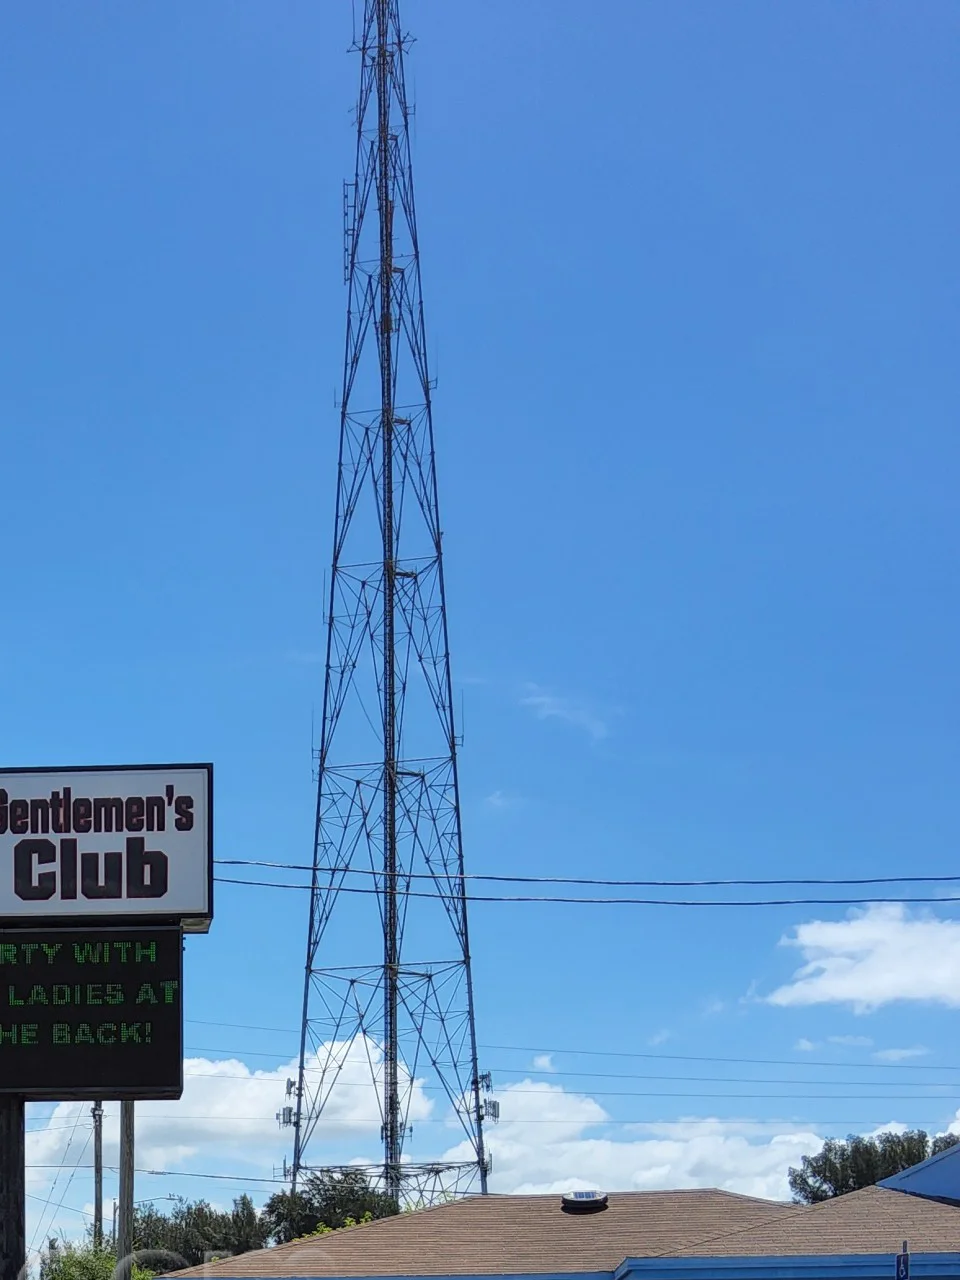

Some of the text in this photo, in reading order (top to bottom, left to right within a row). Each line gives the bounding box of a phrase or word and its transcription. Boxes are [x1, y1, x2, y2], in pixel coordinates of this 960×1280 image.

[13, 836, 169, 901] Club
[72, 941, 157, 963] WITH
[8, 983, 125, 1006] LADIES
[135, 980, 178, 1005] AT
[52, 1022, 152, 1044] BACK!
